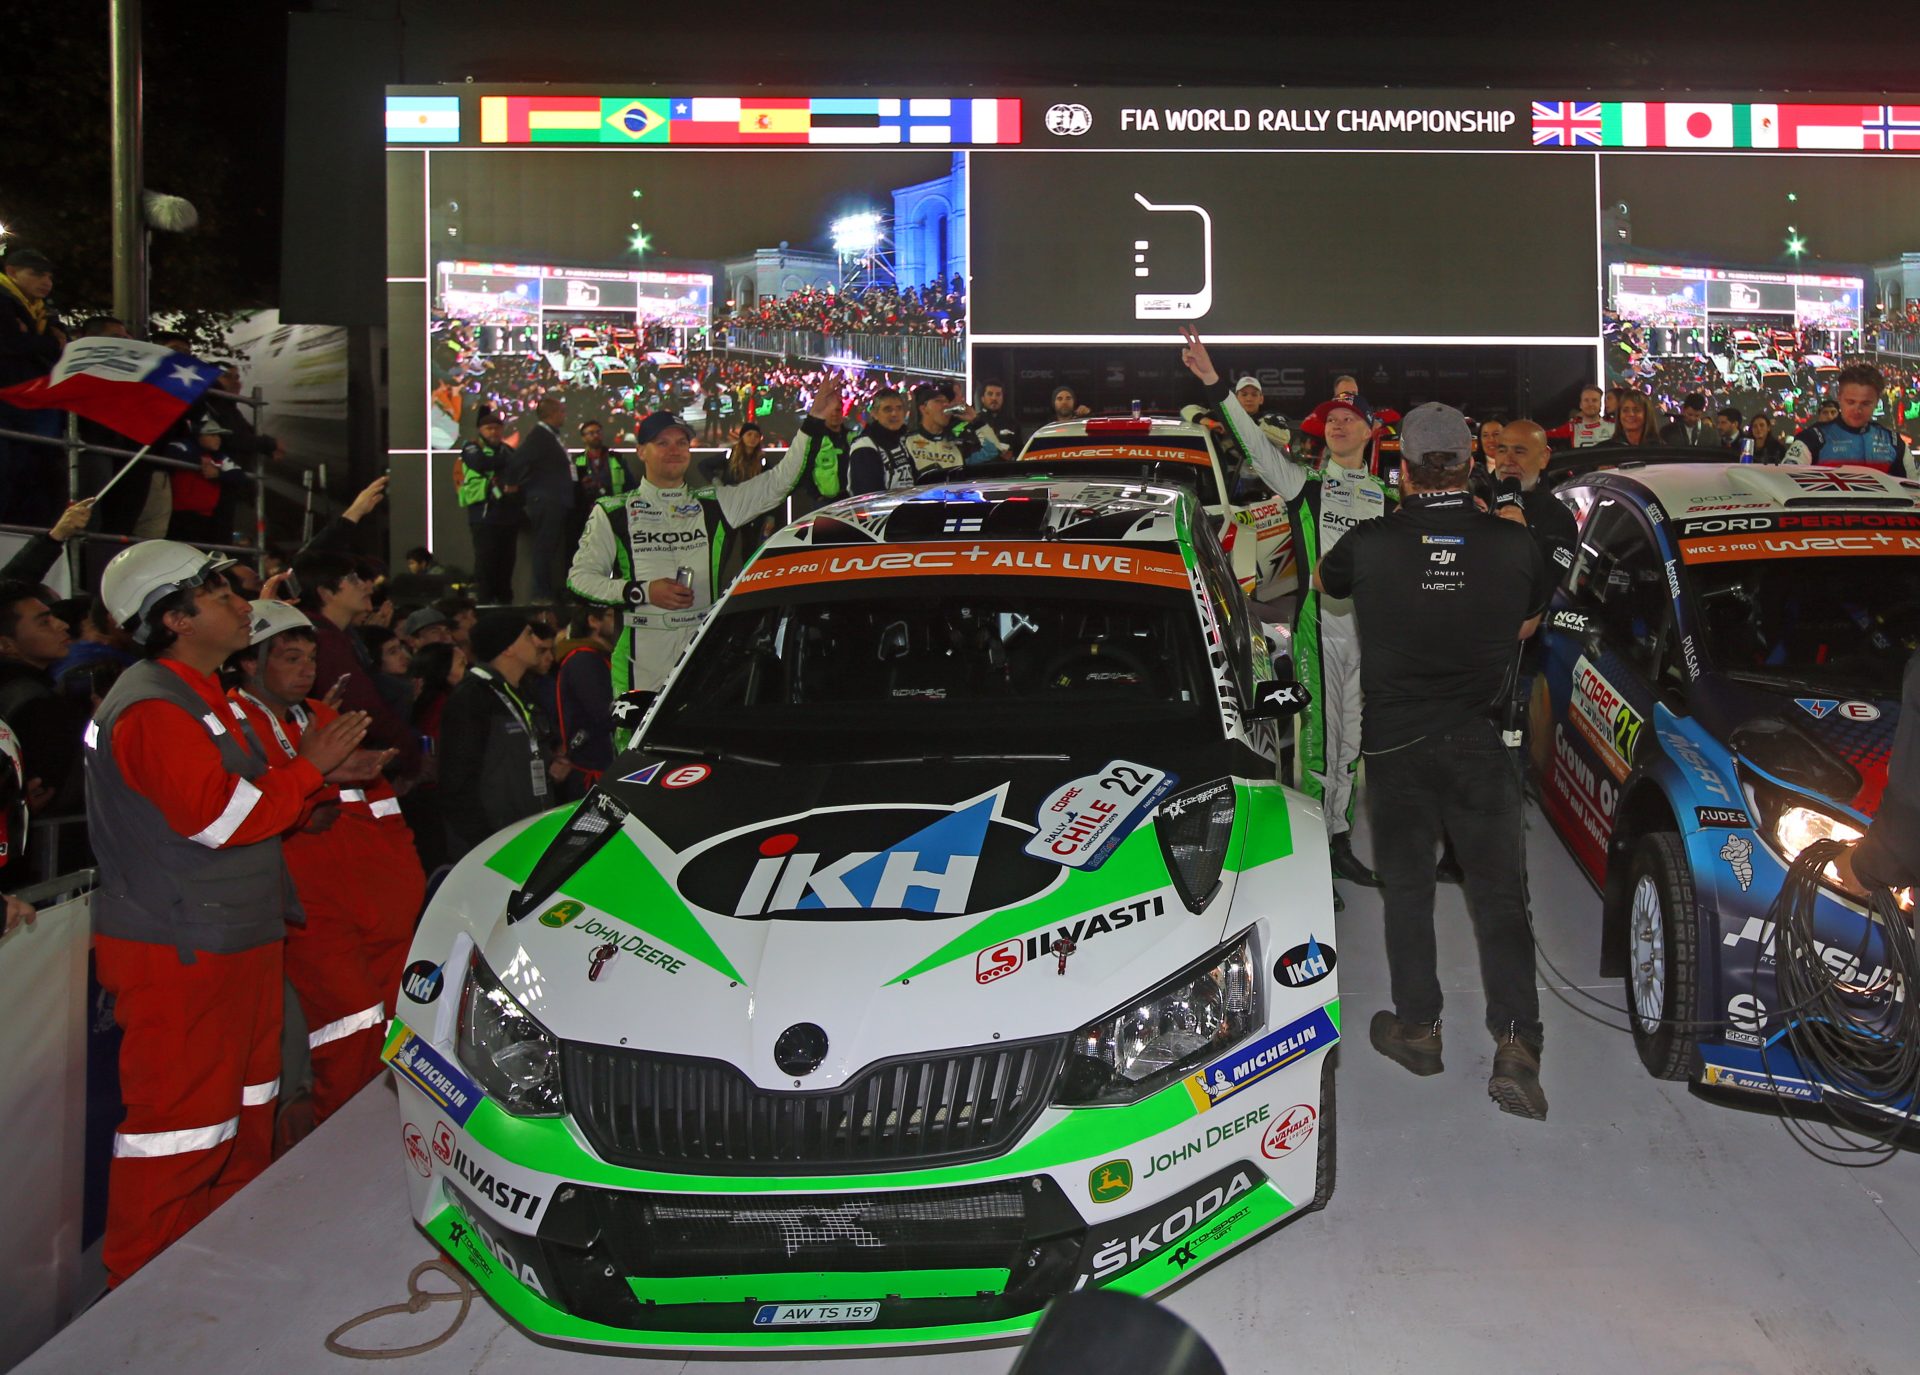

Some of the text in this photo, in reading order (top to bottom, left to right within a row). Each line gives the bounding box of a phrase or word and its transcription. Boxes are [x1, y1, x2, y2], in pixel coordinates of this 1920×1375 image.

[1120, 108, 1516, 132] FIA WORLD RALLY CHAMPIONSHIP
[1128, 449, 1153, 457] ALL
[1156, 450, 1185, 459] LIVE
[1322, 511, 1358, 527] ŠKO
[1684, 517, 1772, 535] FORD
[632, 528, 707, 545] ŠKODA
[1686, 545, 1715, 555] WRC
[1718, 544, 1728, 552] 2
[1730, 543, 1757, 552] PRO
[741, 569, 773, 584] WRC
[775, 567, 784, 577] 2
[788, 562, 819, 575] PRO
[992, 550, 1052, 568] ALL
[1062, 553, 1132, 574] LIVE
[1554, 610, 1589, 627] NGK
[1681, 634, 1700, 682] PULSAR
[1579, 667, 1620, 725] COPEC
[1615, 707, 1641, 767] 21
[1555, 722, 1595, 798] Crown
[1100, 766, 1154, 797] 22
[1570, 793, 1584, 819] and
[1700, 809, 1748, 823] AUDES
[1044, 822, 1068, 844] RALLY
[1051, 799, 1117, 856] CHILE
[574, 918, 687, 975] JOHN DEERE
[1232, 1025, 1317, 1082] MICHELIN
[413, 1057, 468, 1108] MICHELIN
[1738, 1078, 1812, 1097] MICHELIN
[1143, 1103, 1271, 1179] JOHN DEERE
[1274, 1115, 1310, 1143] VAHALA
[1092, 1171, 1253, 1280] ŠKODA
[1190, 1206, 1250, 1246] TOKSPORT
[1213, 1226, 1234, 1240] WRT
[782, 1306, 873, 1320] AW TS 159
